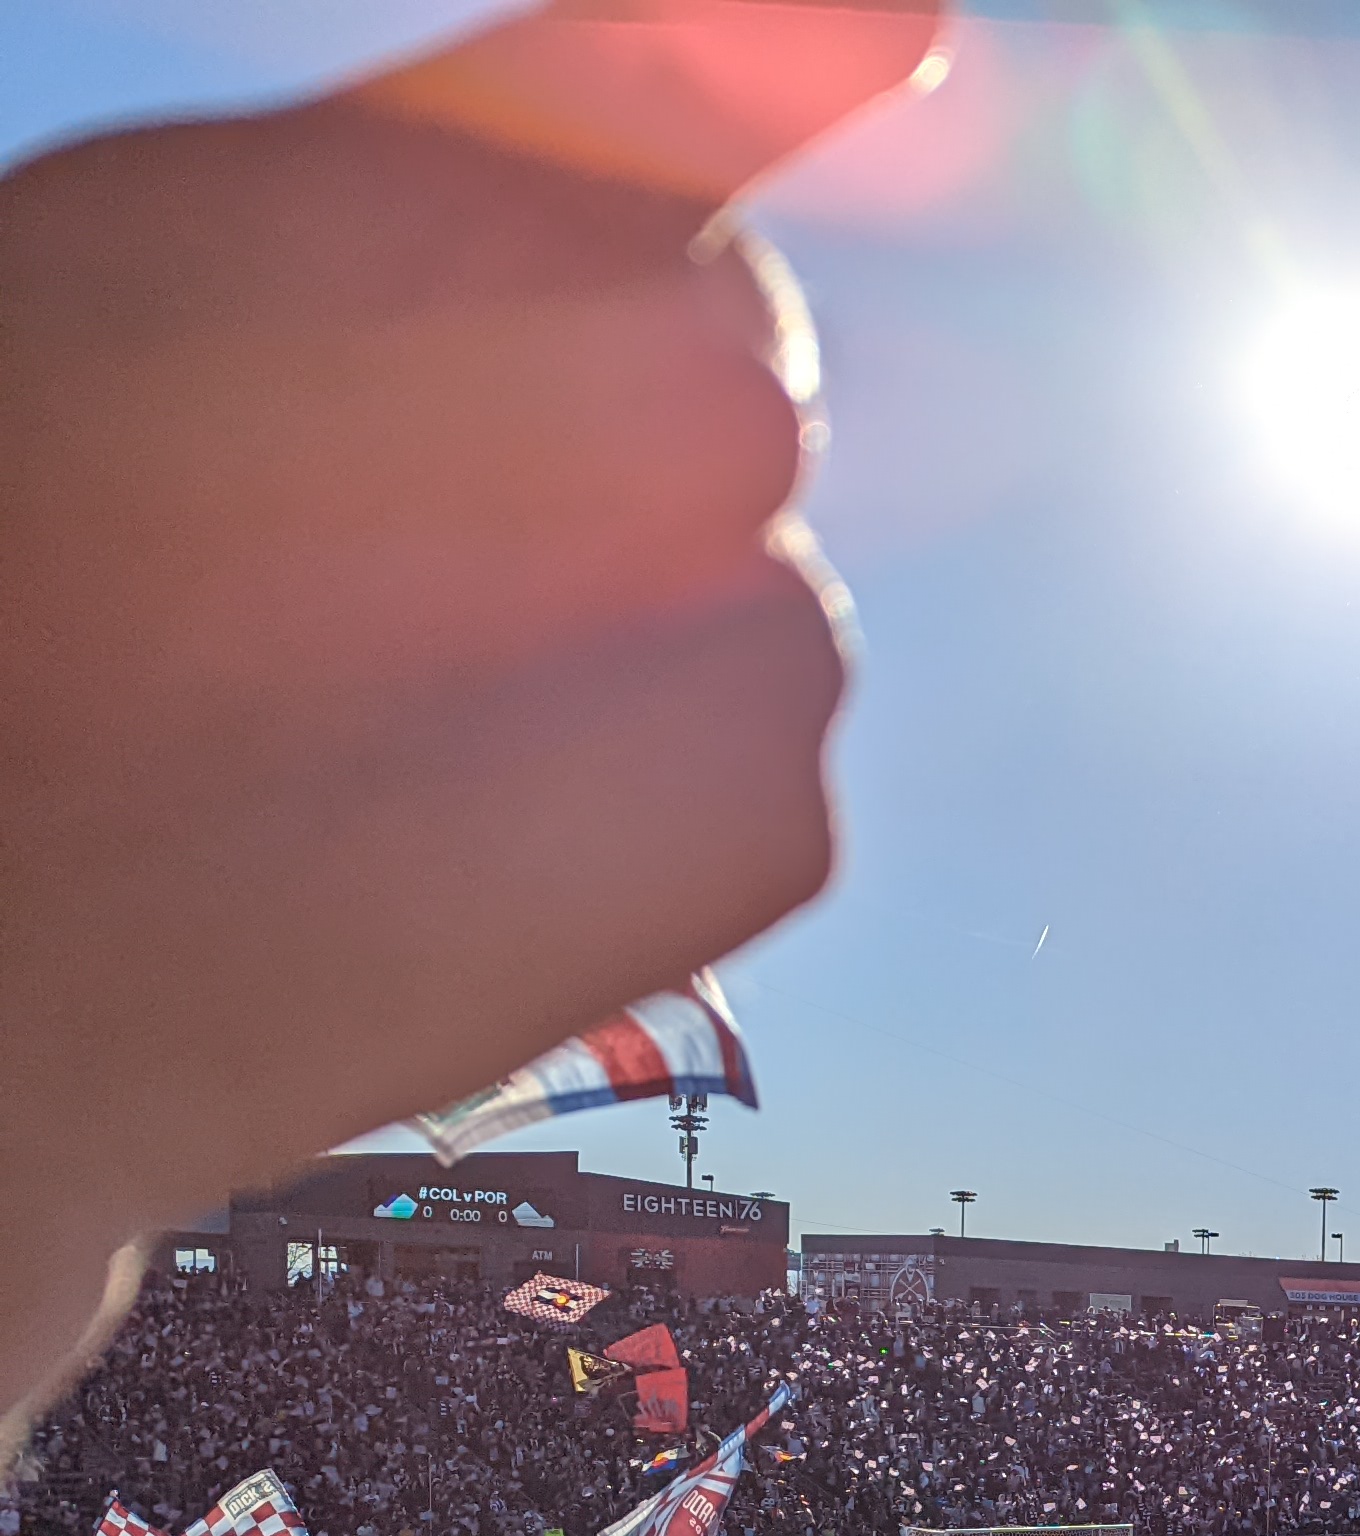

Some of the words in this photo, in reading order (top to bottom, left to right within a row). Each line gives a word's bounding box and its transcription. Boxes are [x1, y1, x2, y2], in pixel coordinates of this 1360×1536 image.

[423, 1206, 432, 1218] 0
[450, 1208, 481, 1222] 0:00
[498, 1211, 507, 1223] 0
[531, 1250, 553, 1261] ATM
